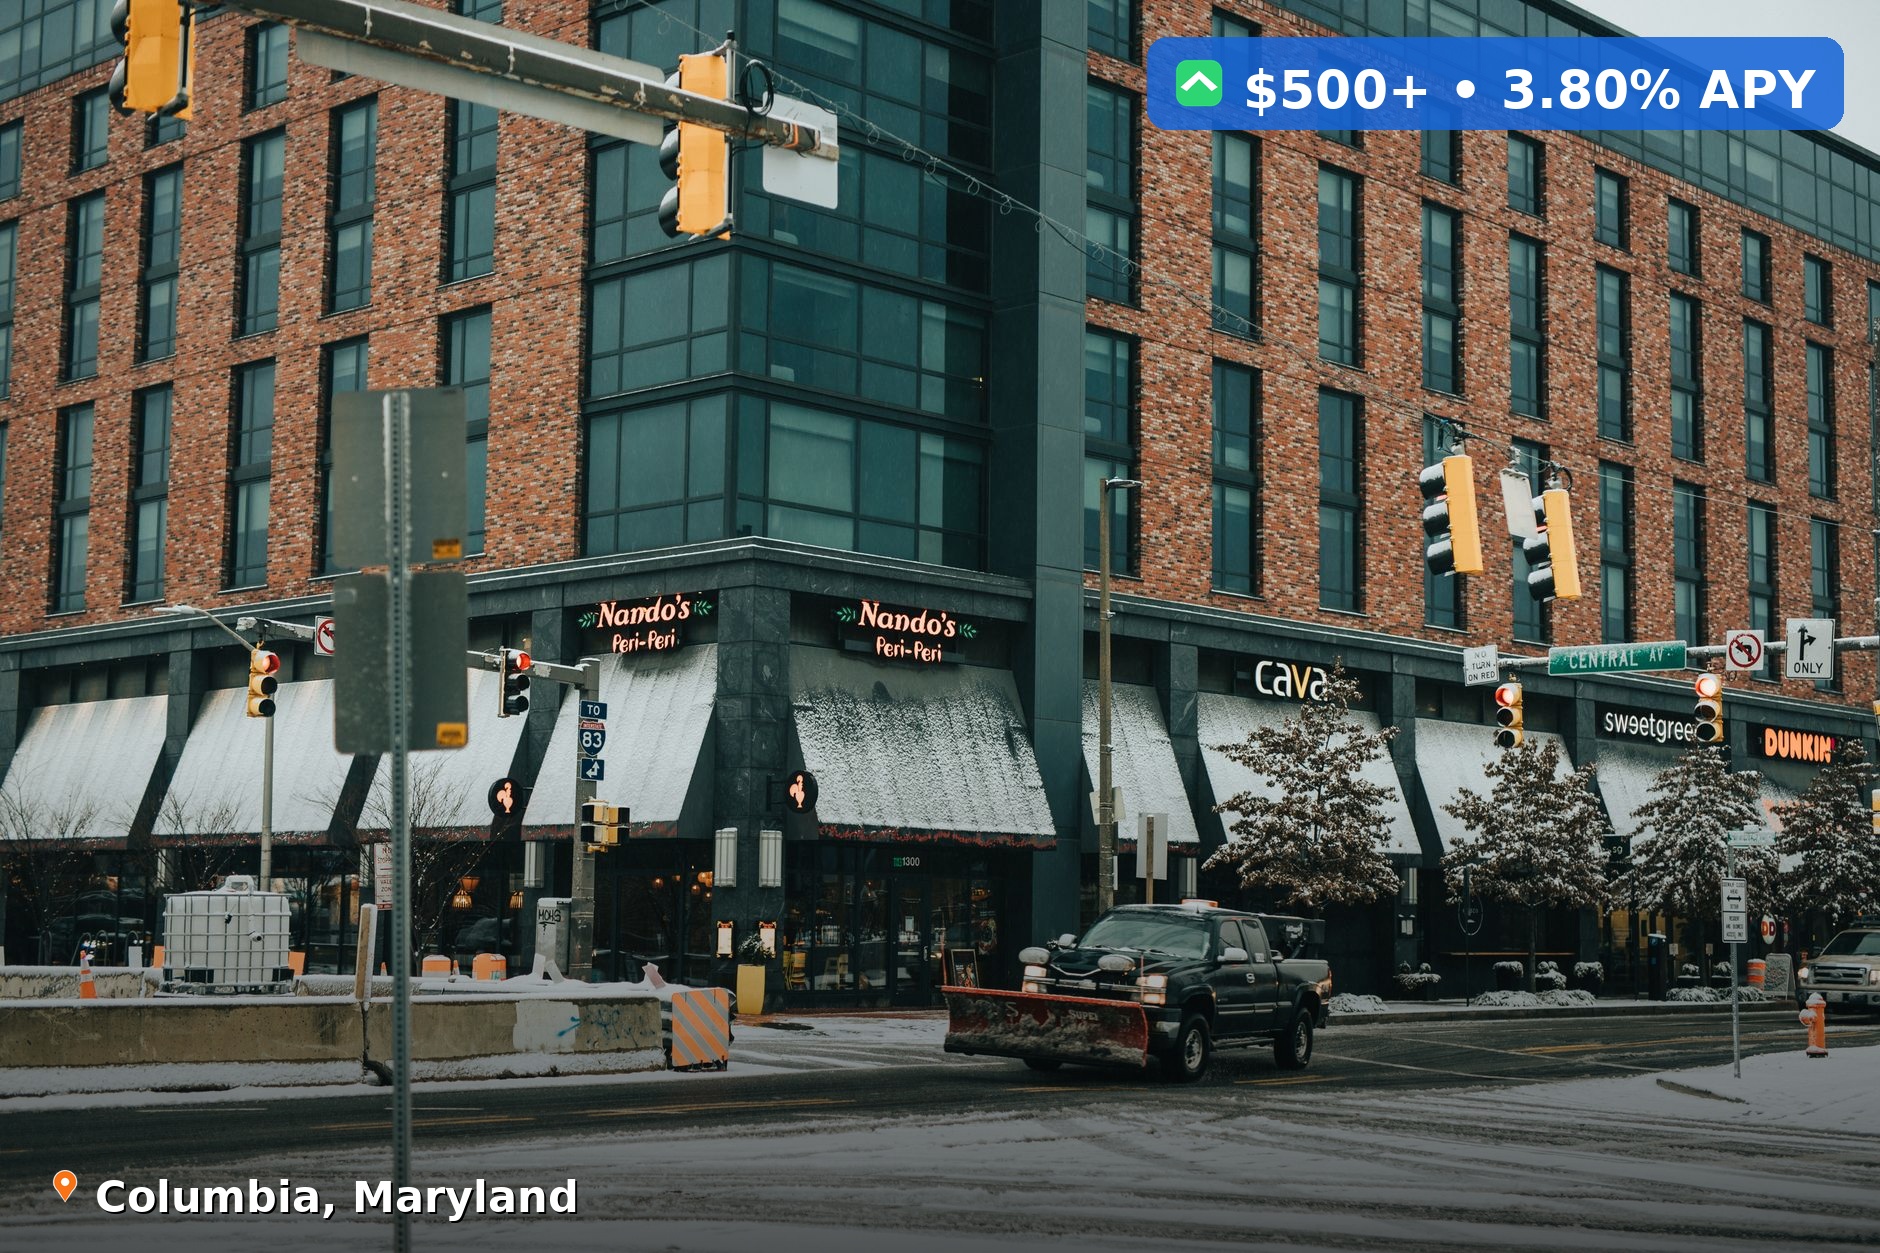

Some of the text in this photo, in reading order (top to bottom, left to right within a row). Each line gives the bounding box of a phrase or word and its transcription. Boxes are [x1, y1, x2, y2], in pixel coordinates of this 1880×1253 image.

[597, 594, 690, 628] Nando's
[858, 600, 956, 638] Nando's
[612, 628, 675, 653] Peri-Peri
[876, 635, 942, 662] Peri-Peri
[1475, 651, 1487, 659] NO
[1569, 646, 1664, 669] CENTRAL AV
[1472, 661, 1491, 670] TURN
[1794, 662, 1824, 674] ONLY
[1255, 660, 1328, 702] cava
[1468, 671, 1496, 682] ON RED
[587, 704, 600, 716] TO
[1604, 712, 1694, 743] sweetgree
[582, 731, 602, 748] 83
[902, 856, 920, 867] 1300
